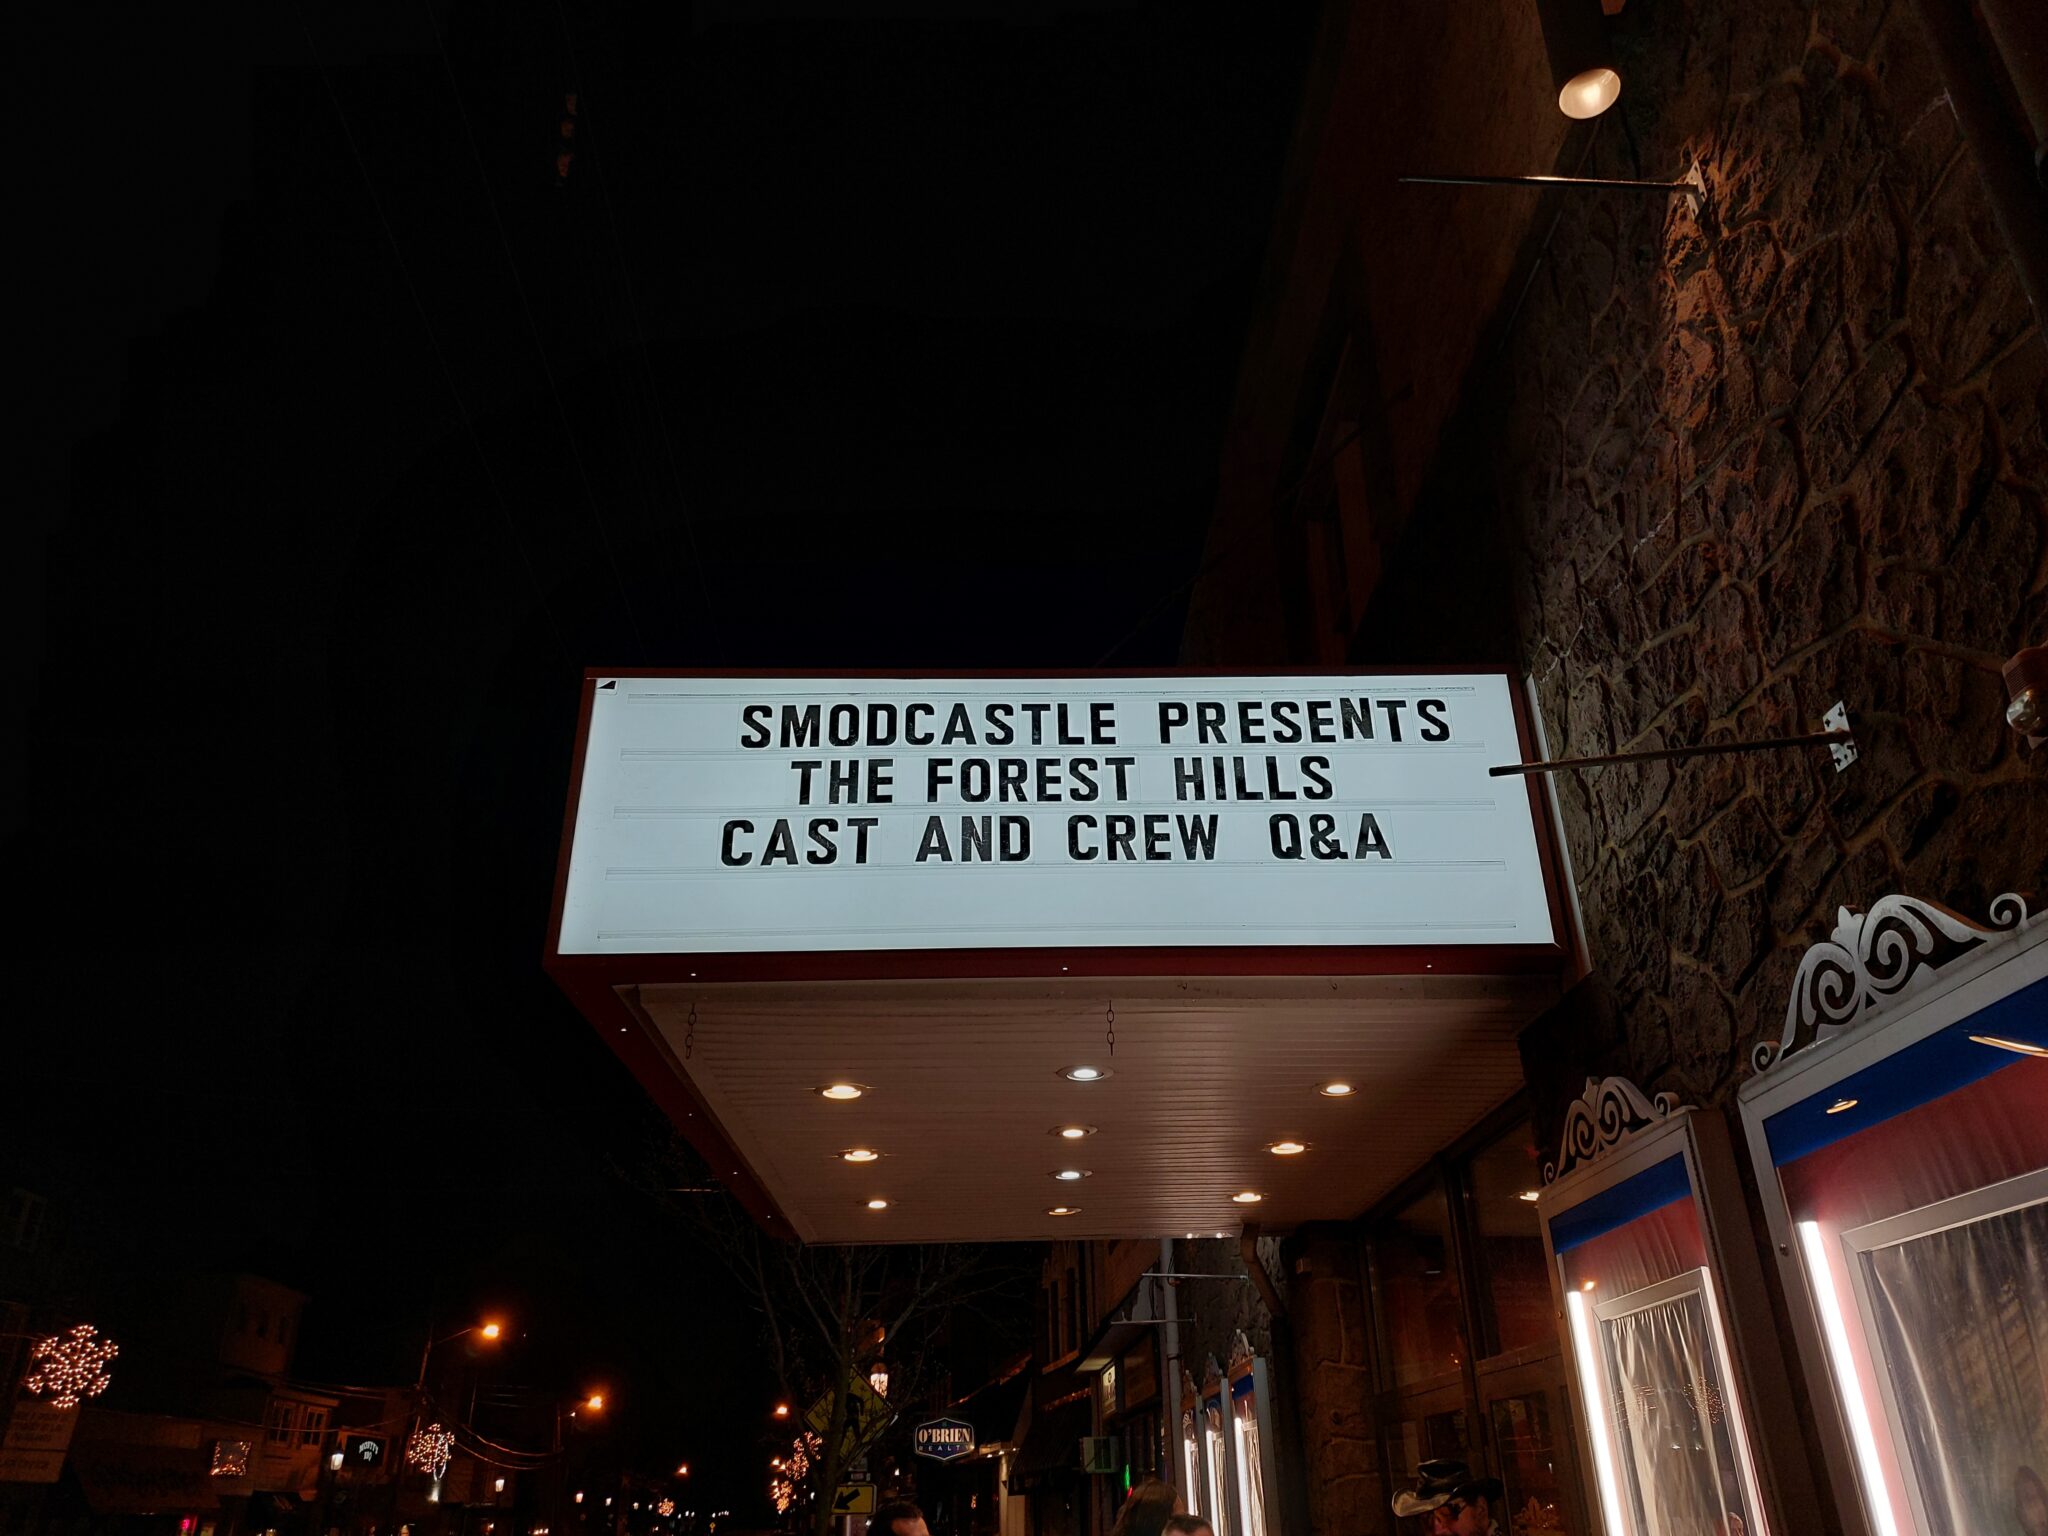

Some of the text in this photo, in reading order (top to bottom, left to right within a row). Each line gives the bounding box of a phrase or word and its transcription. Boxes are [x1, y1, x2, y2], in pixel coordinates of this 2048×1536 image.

[741, 698, 1451, 748] SMODCASTLE PRESENTS
[791, 756, 1334, 805] THE FOREST HILLS
[721, 813, 1393, 867] CAST AND CREW Q&A
[918, 1428, 970, 1443] O'BRIEN
